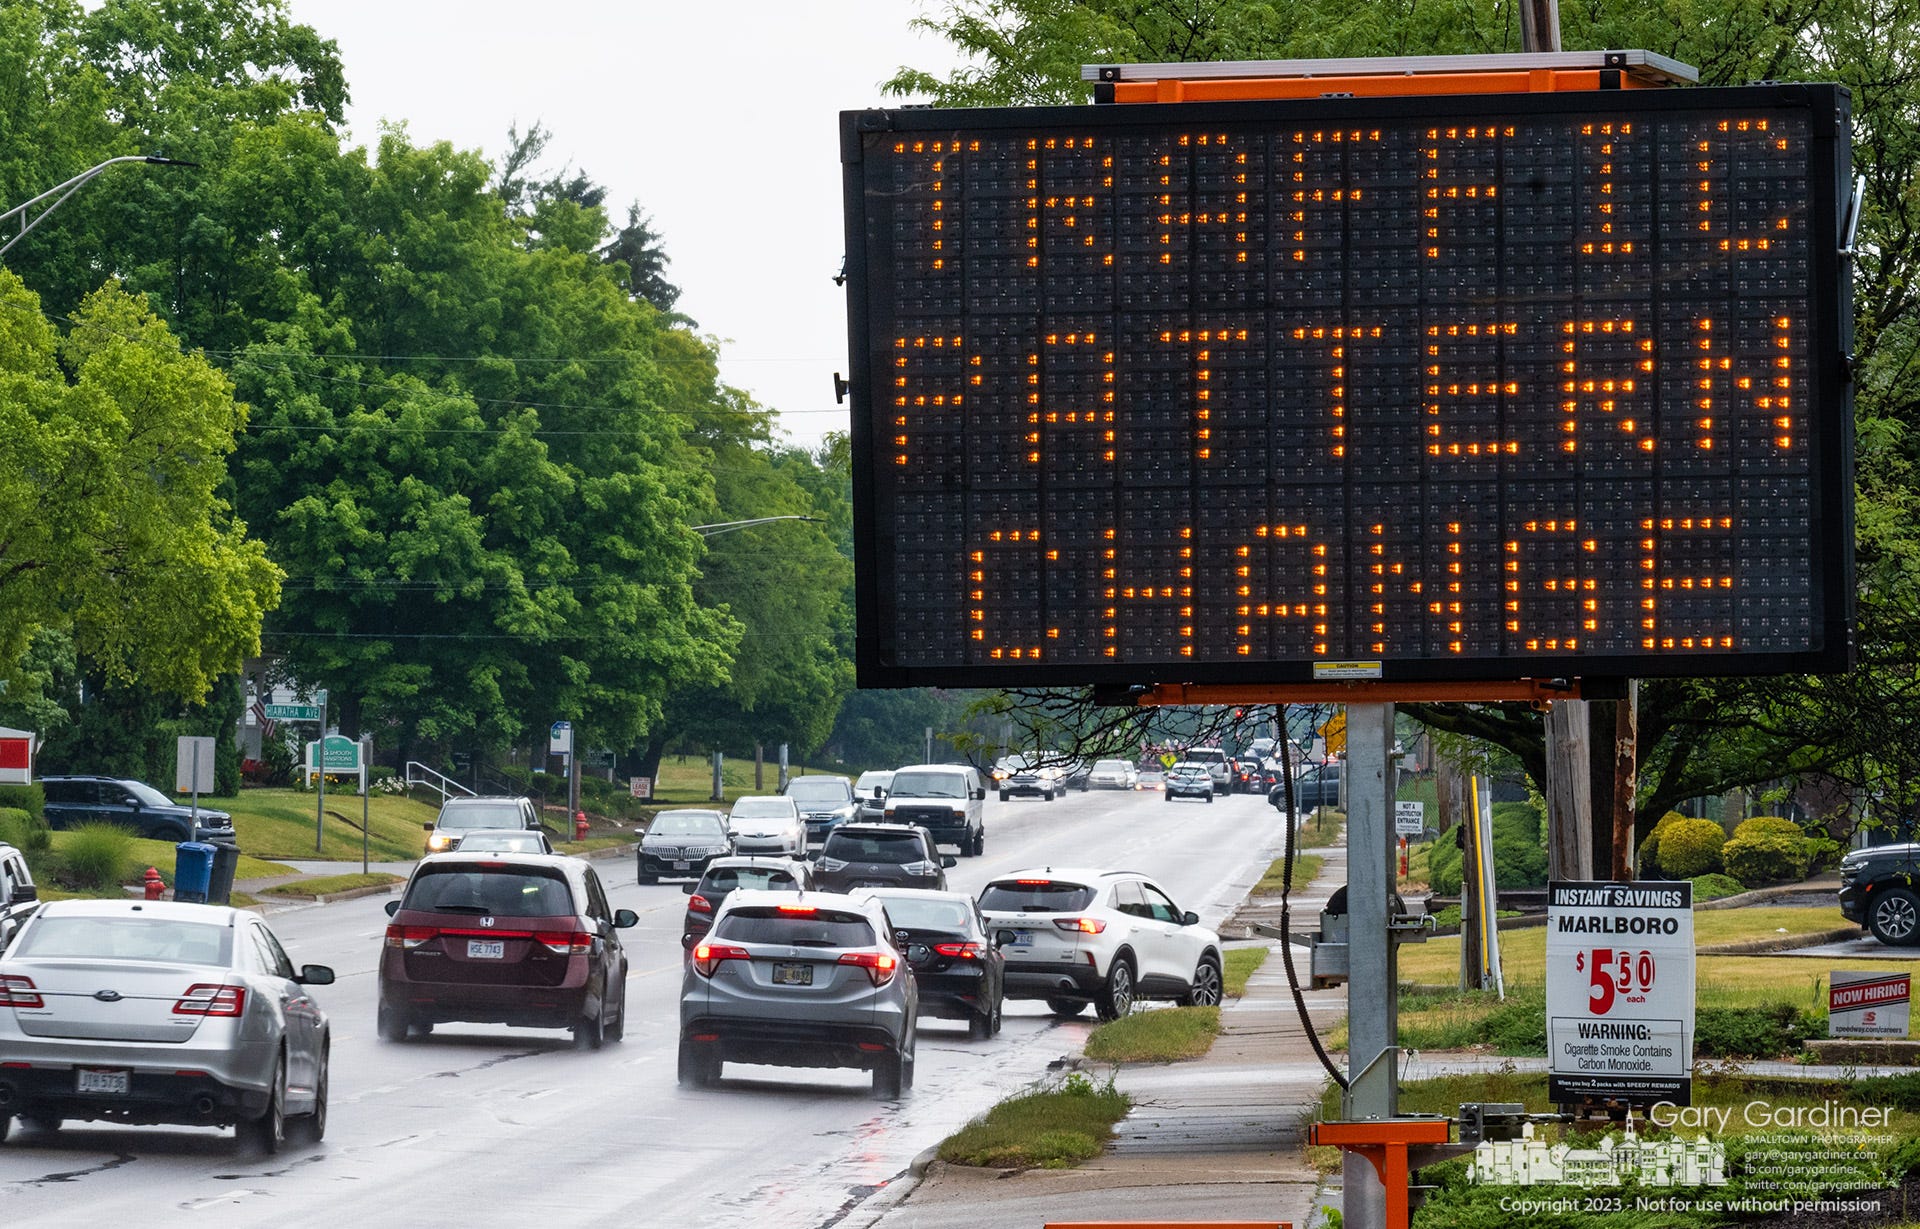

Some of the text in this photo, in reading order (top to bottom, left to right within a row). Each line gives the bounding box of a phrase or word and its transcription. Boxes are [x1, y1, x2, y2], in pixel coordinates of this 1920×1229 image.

[893, 121, 1790, 272] TRAFFIC
[894, 316, 1792, 466] PATTERN
[968, 517, 1735, 659] CHANGE
[266, 706, 318, 718] HIAWATHA AVE
[1554, 888, 1682, 907] INSTANT SAVINGS
[1558, 915, 1679, 935] MARLBORO
[1626, 995, 1646, 1003] each
[1833, 982, 1907, 1005] NOW HIRING
[1578, 1022, 1652, 1041] WARNING:
[1835, 1025, 1903, 1034] speedway.com/careers
[1564, 1042, 1672, 1058] Cigarette Smoke Contains
[1578, 1057, 1654, 1071] Carbon Monoxide.
[1591, 1079, 1596, 1087] 2
